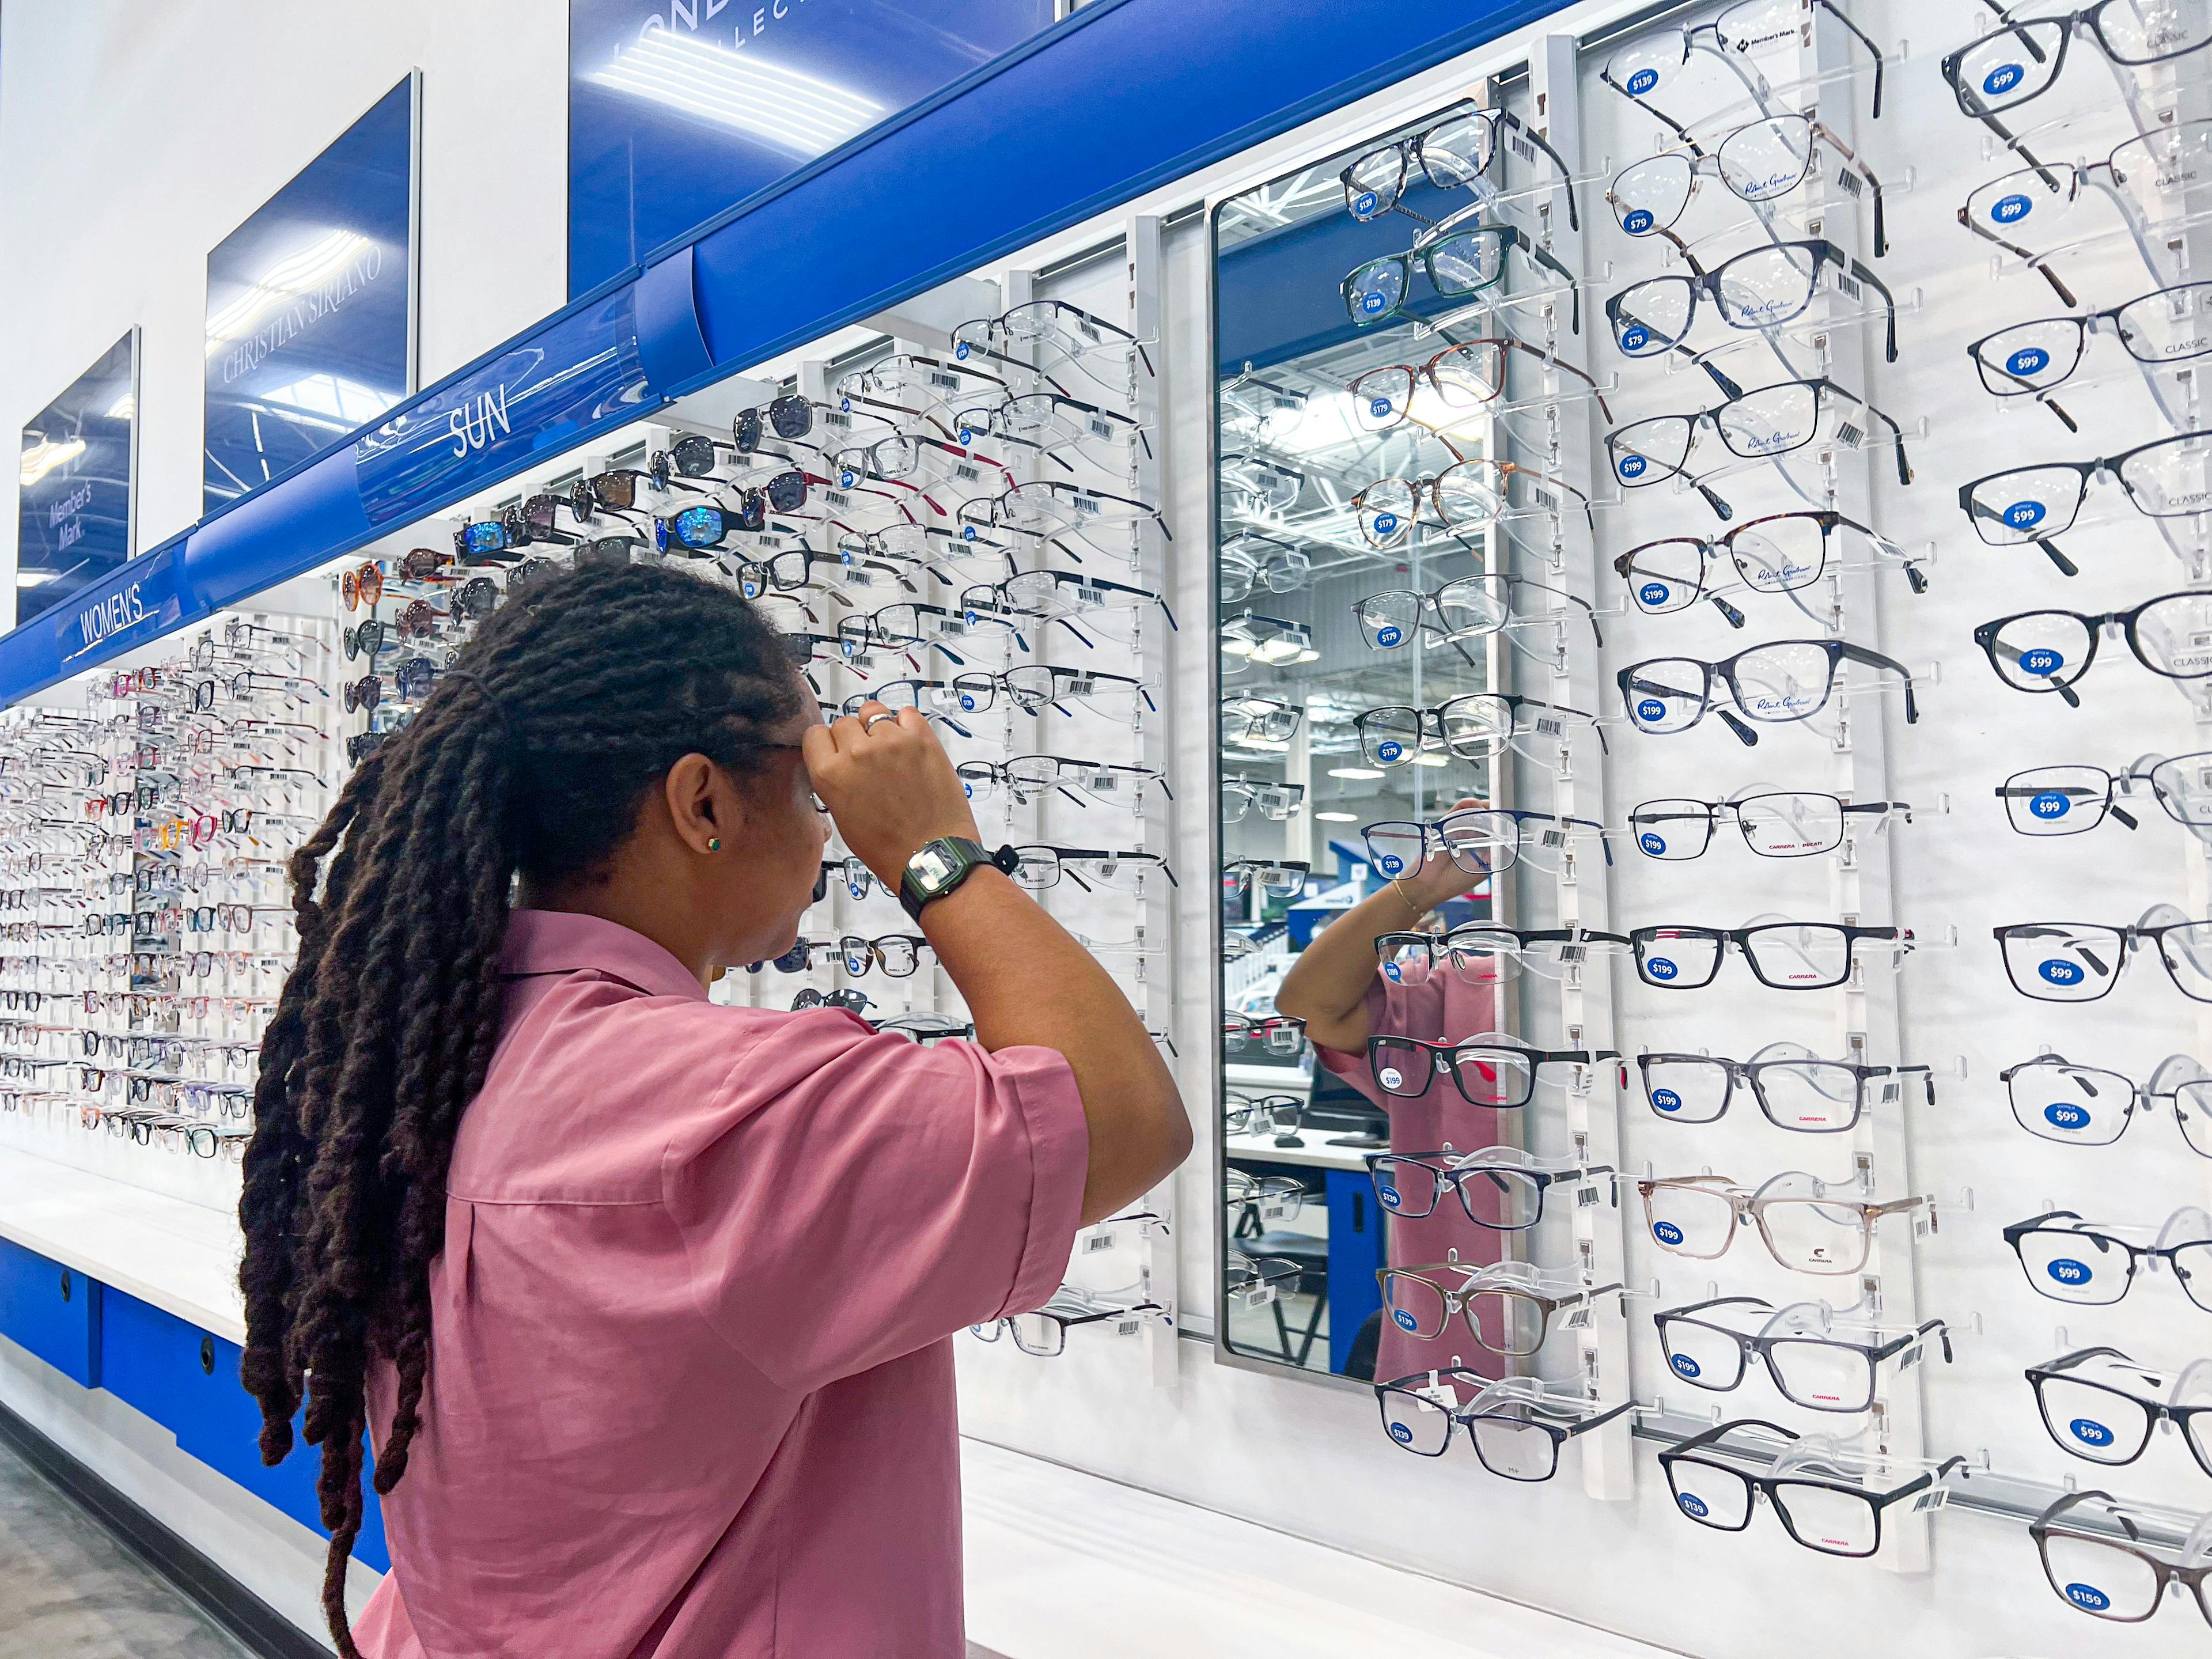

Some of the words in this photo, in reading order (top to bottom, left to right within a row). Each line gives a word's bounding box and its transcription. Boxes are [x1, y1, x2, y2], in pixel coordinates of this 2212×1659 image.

[1751, 33, 1778, 45] Member's
[1779, 29, 1794, 37] Mark
[1633, 74, 1653, 91] $139
[1993, 71, 2014, 89] $99
[1745, 181, 1767, 195] Robert
[1770, 173, 1797, 186] Graham
[2156, 171, 2197, 187] CLASSIC
[1359, 197, 1373, 212] $139
[2001, 202, 2022, 218] $99
[1630, 218, 1647, 231] $79
[1366, 298, 1381, 309] $139
[1741, 305, 1764, 317] Robert
[1766, 300, 1793, 312] Graham
[224, 301, 306, 383] CHRISTIAN
[309, 246, 381, 323] SIRIANO
[1628, 335, 1643, 347] $79
[2165, 337, 2208, 353] CLASSIC
[2018, 355, 2039, 370] $99
[1373, 403, 1388, 415] $179
[449, 383, 511, 459] SUN
[1748, 437, 1770, 449] Robert
[1772, 431, 1800, 444] Graham
[1624, 461, 1642, 474] $199
[50, 480, 91, 529] Member's
[2169, 492, 2212, 506] CLASSIC
[1378, 518, 1393, 529] $179
[2013, 509, 2035, 524] $99
[1758, 569, 1781, 580] Robert
[1783, 565, 1811, 576] Graham
[1645, 589, 1664, 601] $199
[80, 583, 143, 644] WOMEN'S
[1381, 631, 1397, 643] $179
[2030, 656, 2052, 669] $99
[1758, 699, 1780, 710] Robert
[1782, 696, 1810, 709] Graham
[1642, 705, 1661, 716] $199
[1382, 747, 1398, 757] $179
[2039, 801, 2061, 814] $99
[1645, 838, 1662, 850] $199
[1385, 860, 1400, 869] $139
[1653, 963, 1673, 975] $199
[2050, 965, 2073, 979] $99
[1657, 1094, 1676, 1106] $199
[2056, 1109, 2078, 1122] $99
[1382, 1192, 1398, 1204] $139
[1659, 1226, 1679, 1240] $199
[2058, 1266, 2081, 1279] $99
[1397, 1314, 1413, 1327] $139
[1677, 1359, 1696, 1373] $199
[1393, 1428, 1410, 1440] $139
[2080, 1425, 2103, 1440] $99
[1684, 1499, 1704, 1514] $139
[1821, 1538, 1849, 1547] CARRERA
[2073, 1589, 2103, 1606] $159
